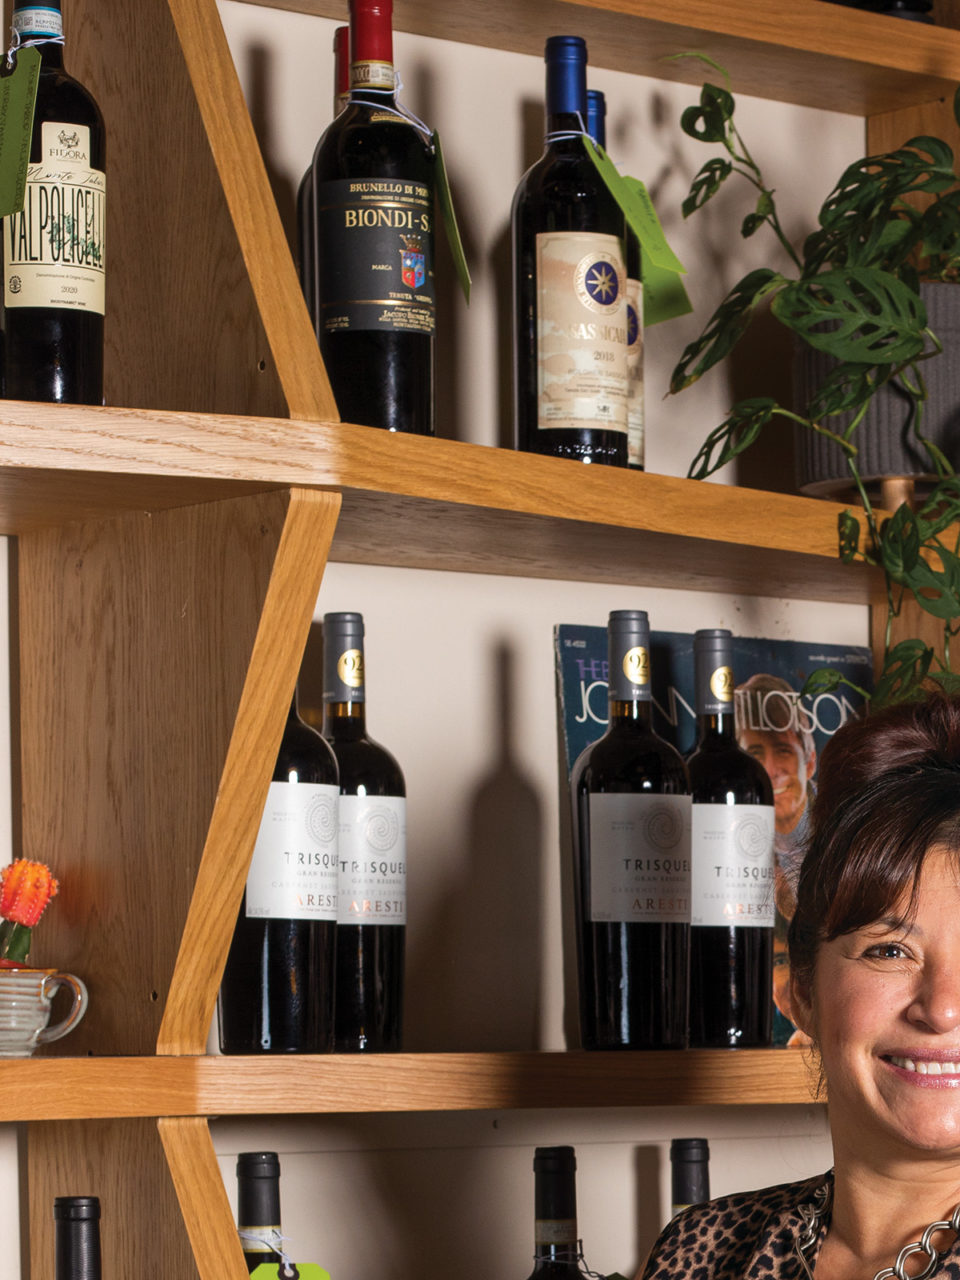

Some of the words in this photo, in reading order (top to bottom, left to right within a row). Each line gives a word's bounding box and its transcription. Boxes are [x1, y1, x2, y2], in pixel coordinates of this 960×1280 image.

[49, 148, 87, 161] FIDORA
[350, 183, 402, 193] BRUNELLO
[404, 185, 413, 195] DI
[9, 185, 105, 268] VALPOLICELL
[345, 208, 430, 232] BIONDI-S
[60, 286, 78, 294] 2020
[593, 351, 615, 361] 2018
[629, 653, 648, 670] 92
[349, 899, 403, 913] ARESTI
[632, 897, 688, 911] ARESTI
